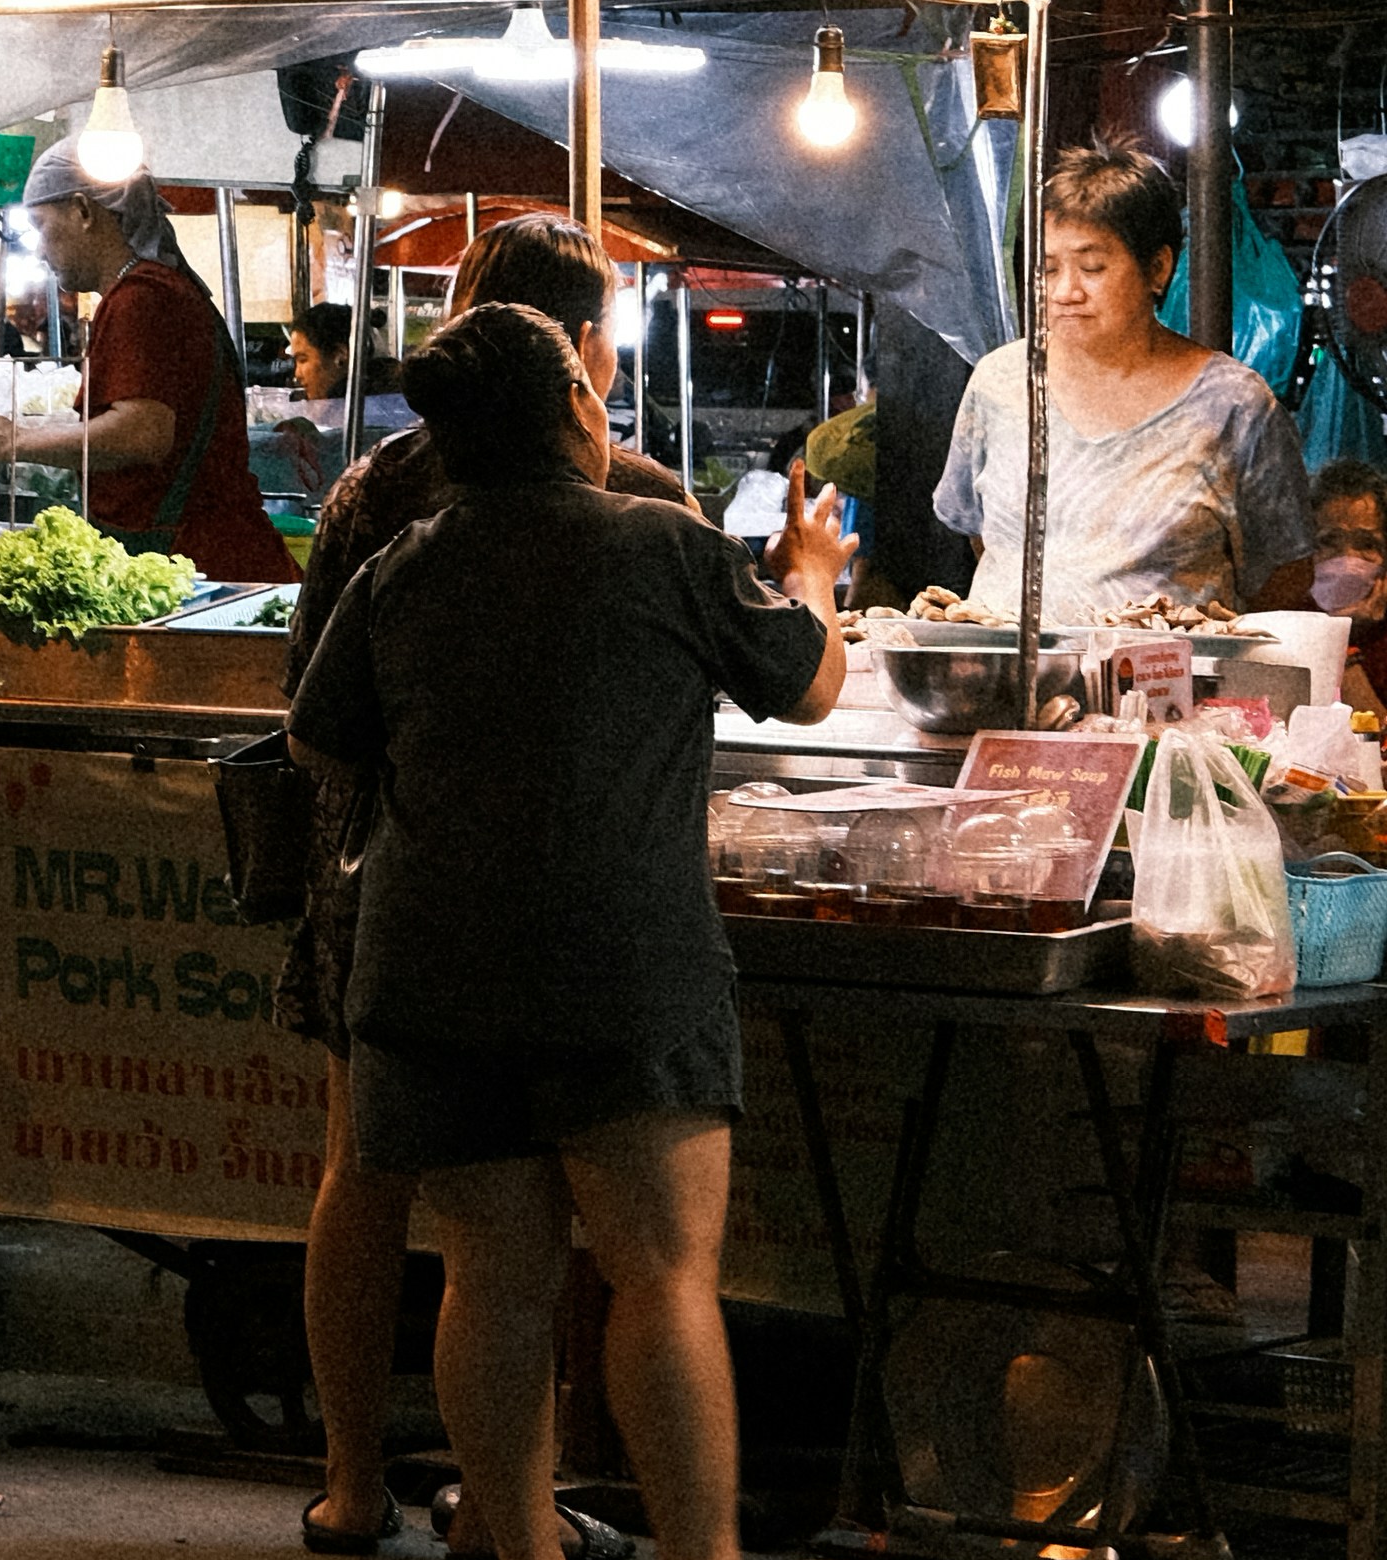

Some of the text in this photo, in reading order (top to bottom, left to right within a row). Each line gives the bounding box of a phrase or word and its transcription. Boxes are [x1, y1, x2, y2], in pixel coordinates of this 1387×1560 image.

[988, 764, 1109, 785] Fish Maw Soup
[13, 846, 239, 926] MR.We
[16, 937, 159, 1011] Pork
[15, 1119, 198, 1173] นายเว้ง
